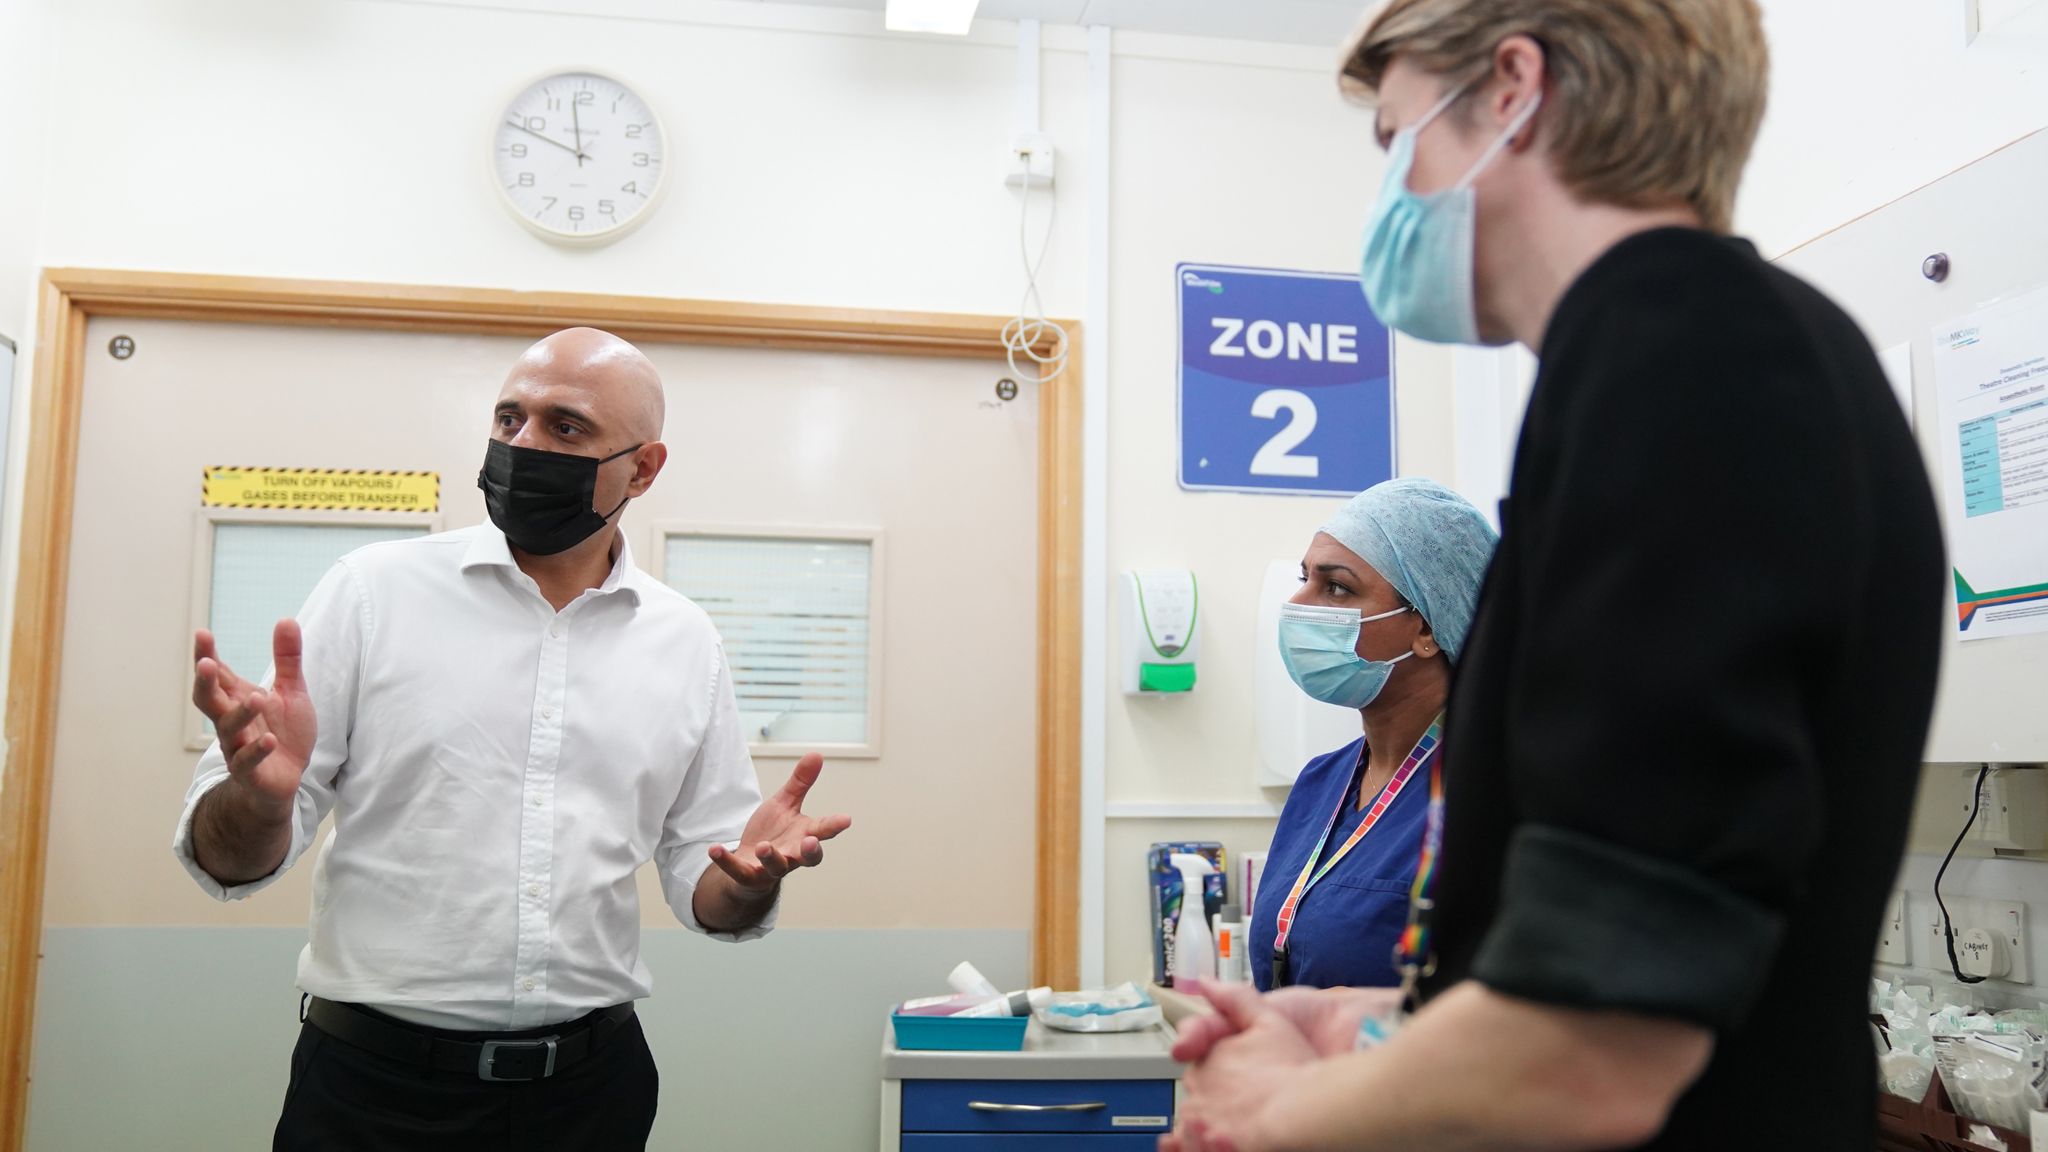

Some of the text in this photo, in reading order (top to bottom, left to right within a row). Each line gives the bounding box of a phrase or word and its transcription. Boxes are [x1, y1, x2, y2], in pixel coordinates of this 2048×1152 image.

[548, 98, 560, 111] 11
[573, 92, 595, 106] 12
[523, 117, 546, 131] 10
[626, 124, 642, 139] 2
[511, 144, 527, 158] 9
[632, 153, 649, 167] 3
[518, 172, 535, 187] 8
[621, 181, 637, 194] 4
[542, 197, 557, 211] 7
[598, 200, 615, 214] 5
[568, 206, 584, 221] 6
[1209, 317, 1358, 363] ZONE
[1979, 378, 2002, 390] Theatre
[2003, 371, 2030, 384] Cleaning
[1249, 388, 1319, 477] 2
[263, 476, 299, 487] TURN
[303, 477, 328, 487] OFF
[332, 478, 394, 490] VAPOURS
[242, 490, 419, 504] GASES BEFORE TRANSFER
[1964, 942, 1989, 952] CABINET
